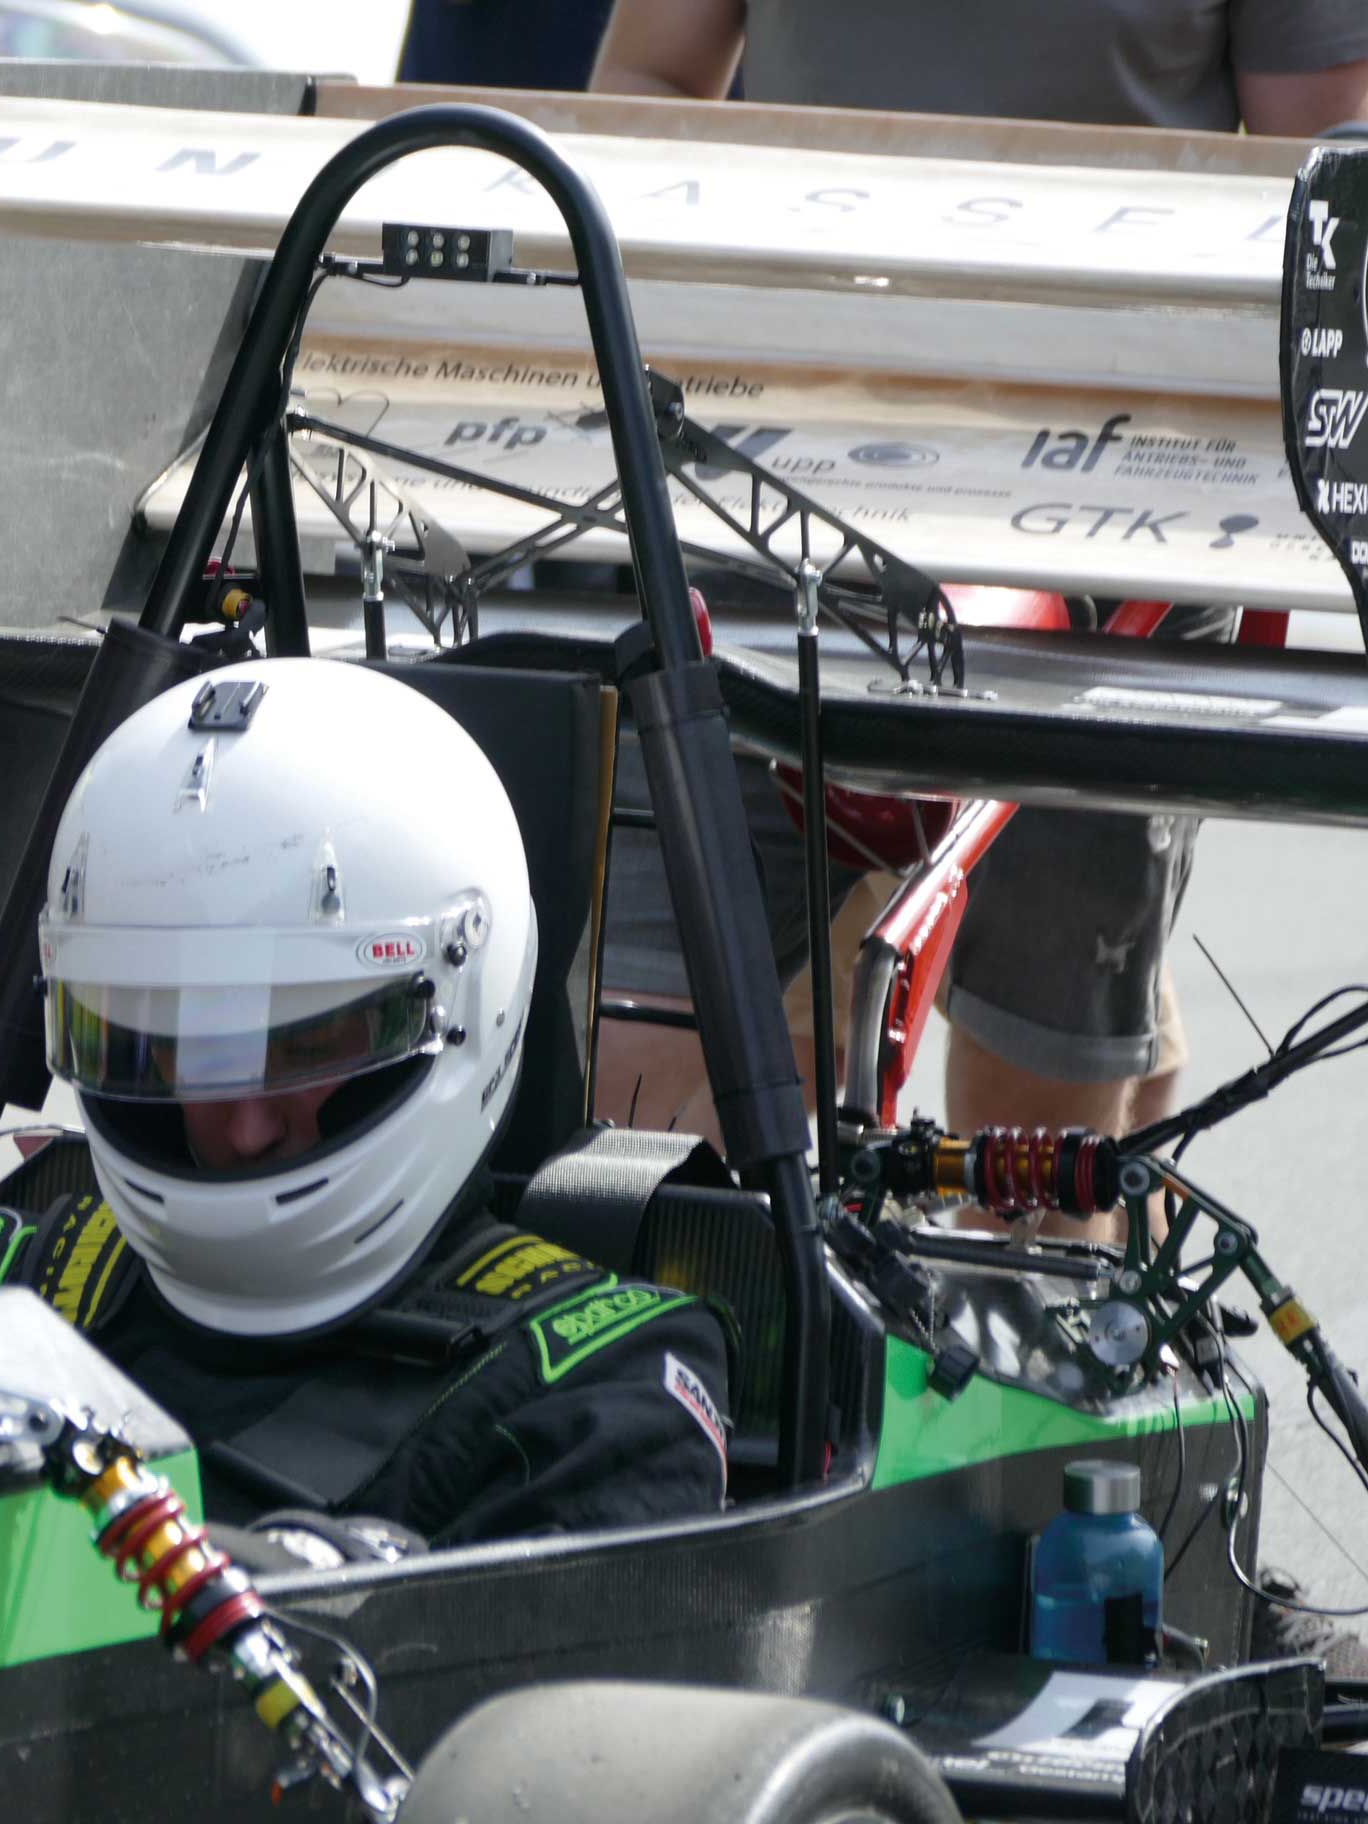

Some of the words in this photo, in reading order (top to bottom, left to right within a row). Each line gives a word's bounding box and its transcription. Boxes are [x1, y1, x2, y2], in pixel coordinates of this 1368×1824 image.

[1312, 329, 1343, 358] LAPP
[303, 352, 429, 378] lektrische
[436, 360, 579, 388] Maschinen
[685, 375, 764, 397] triebe
[444, 414, 549, 450] pfp
[1010, 502, 1192, 544] GTK
[372, 943, 415, 959] BELL
